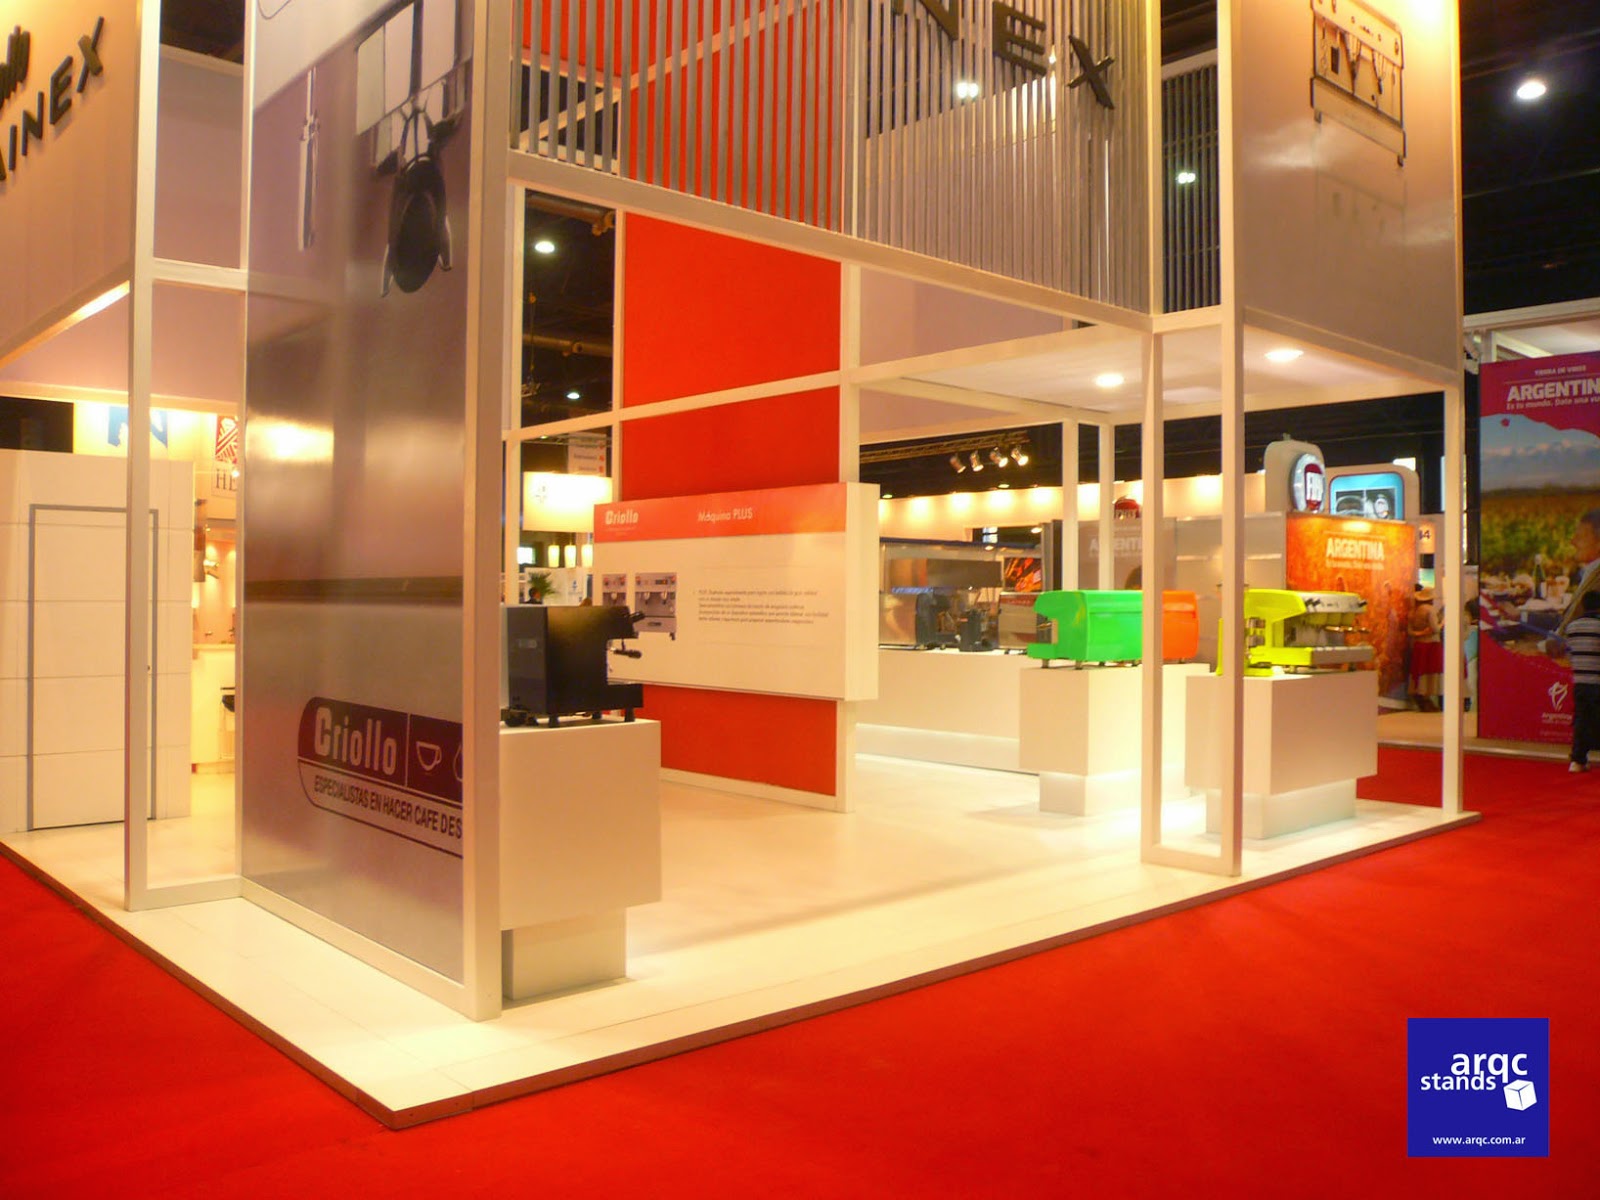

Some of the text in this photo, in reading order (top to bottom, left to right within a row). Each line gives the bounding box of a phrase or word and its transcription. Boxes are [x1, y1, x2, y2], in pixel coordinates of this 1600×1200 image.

[0, 16, 105, 181] INEX
[1507, 378, 1600, 402] ARGENTIN
[605, 509, 639, 525] Criollo
[733, 507, 753, 520] PLUS
[1326, 537, 1384, 562] ARGENTINA
[314, 706, 397, 776] Criollo
[313, 775, 370, 808] ESPECIALISTAS
[369, 791, 382, 813] EN
[383, 795, 414, 823] HACER
[413, 804, 439, 832] CAFE
